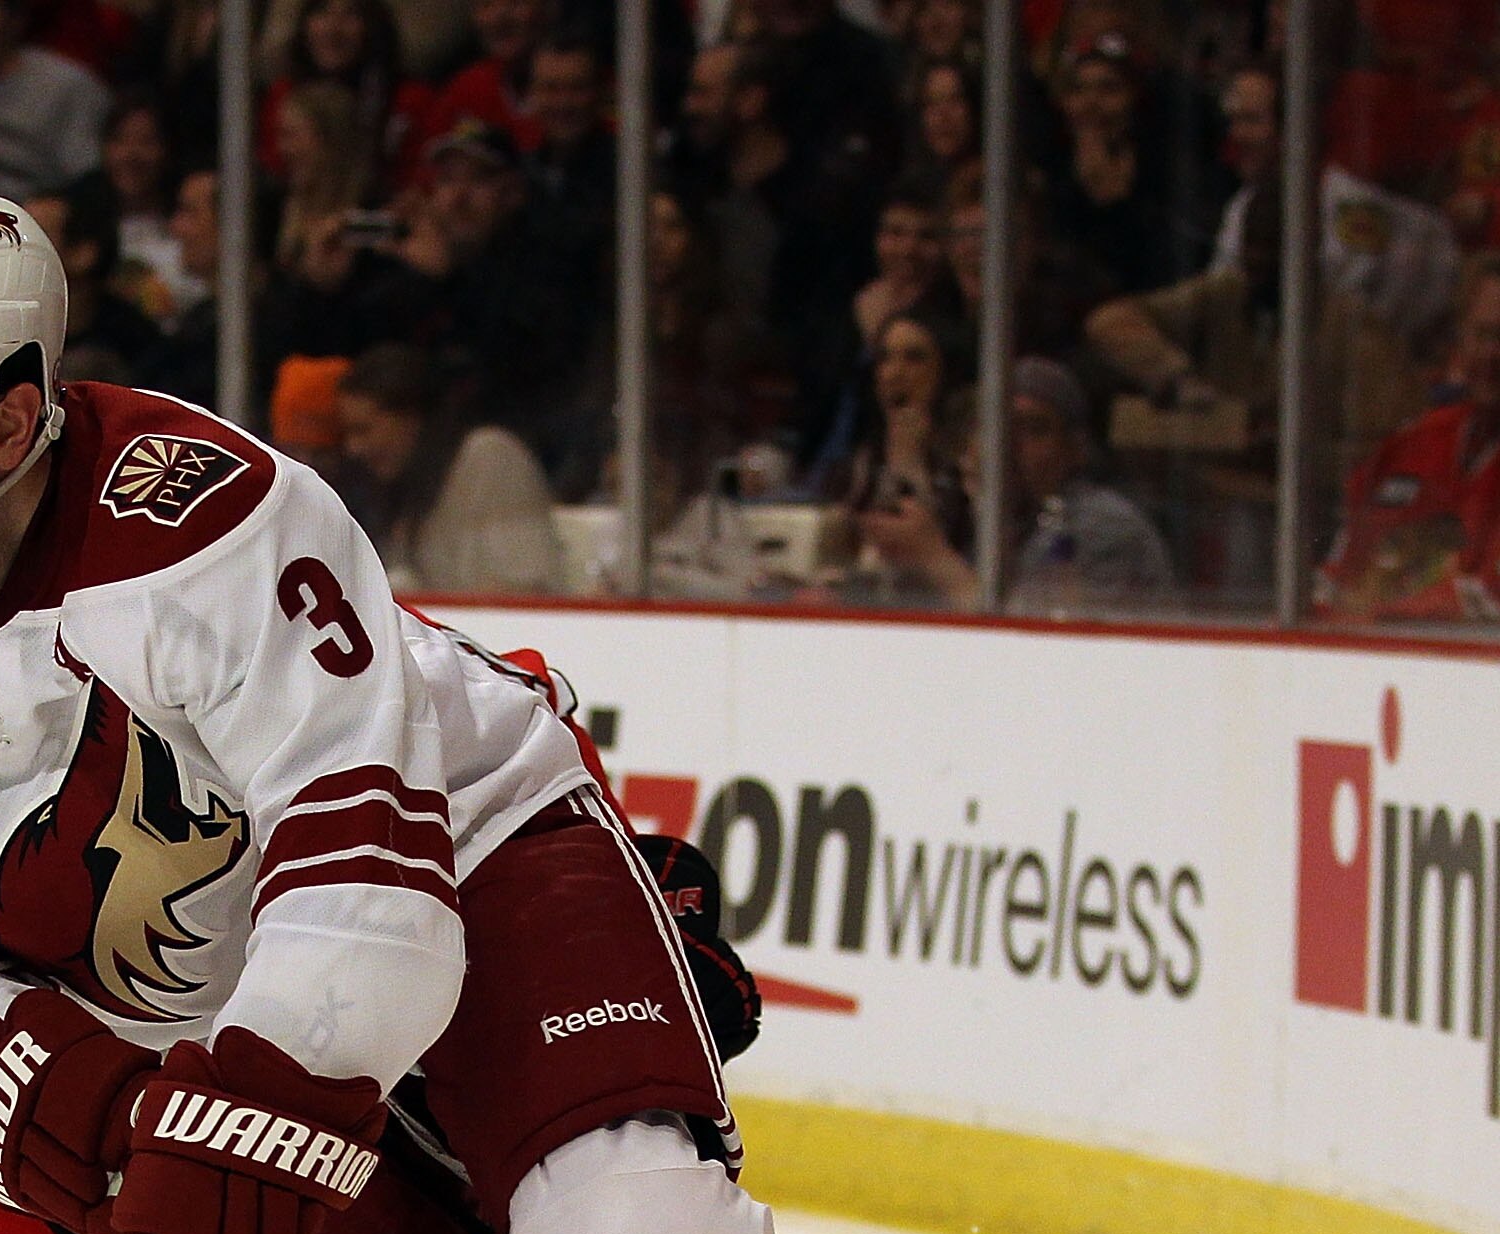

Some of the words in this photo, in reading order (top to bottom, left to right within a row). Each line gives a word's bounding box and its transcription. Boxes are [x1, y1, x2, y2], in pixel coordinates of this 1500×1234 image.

[156, 449, 217, 507] PHX
[276, 555, 375, 679] 3
[884, 796, 1204, 1000] wireless
[539, 996, 672, 1045] Reebok
[153, 1090, 380, 1200] WARRIOR
